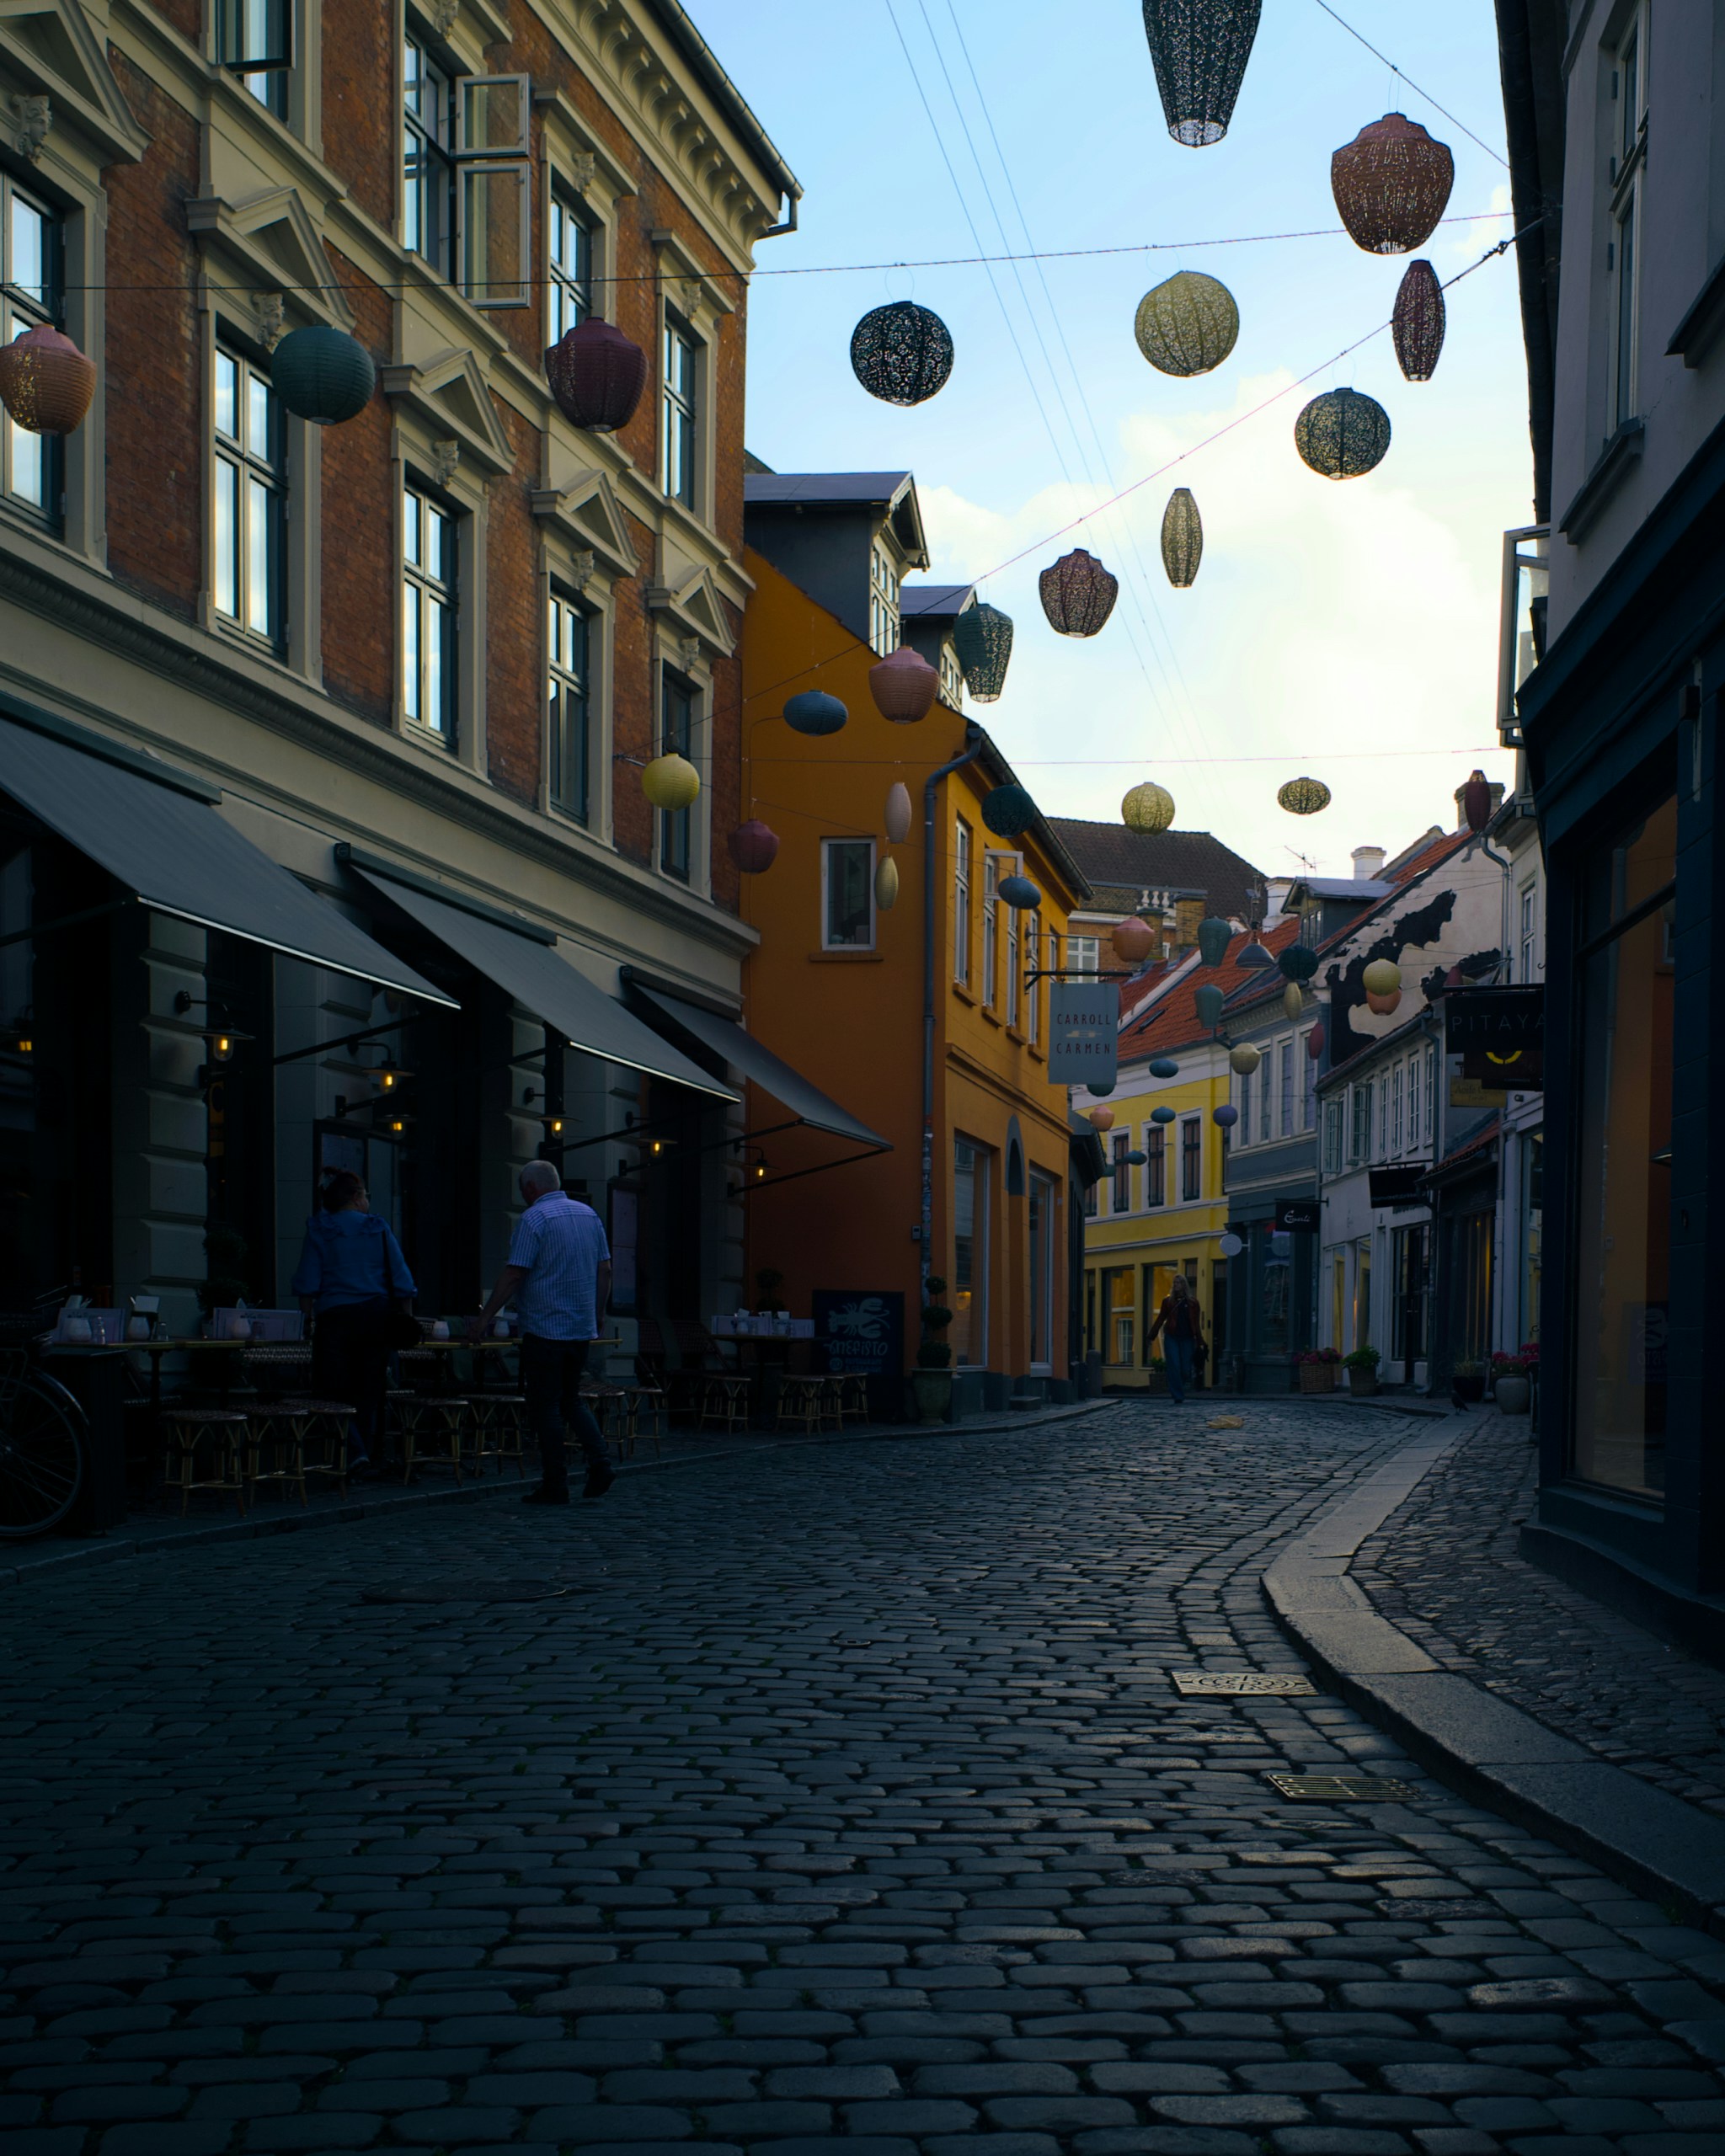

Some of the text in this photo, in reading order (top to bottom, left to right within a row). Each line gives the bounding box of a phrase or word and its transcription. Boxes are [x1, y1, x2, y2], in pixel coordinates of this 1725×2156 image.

[1056, 1014, 1111, 1025] CARROLL
[1451, 1013, 1546, 1032] PITAYA
[1055, 1043, 1110, 1054] CARMEN
